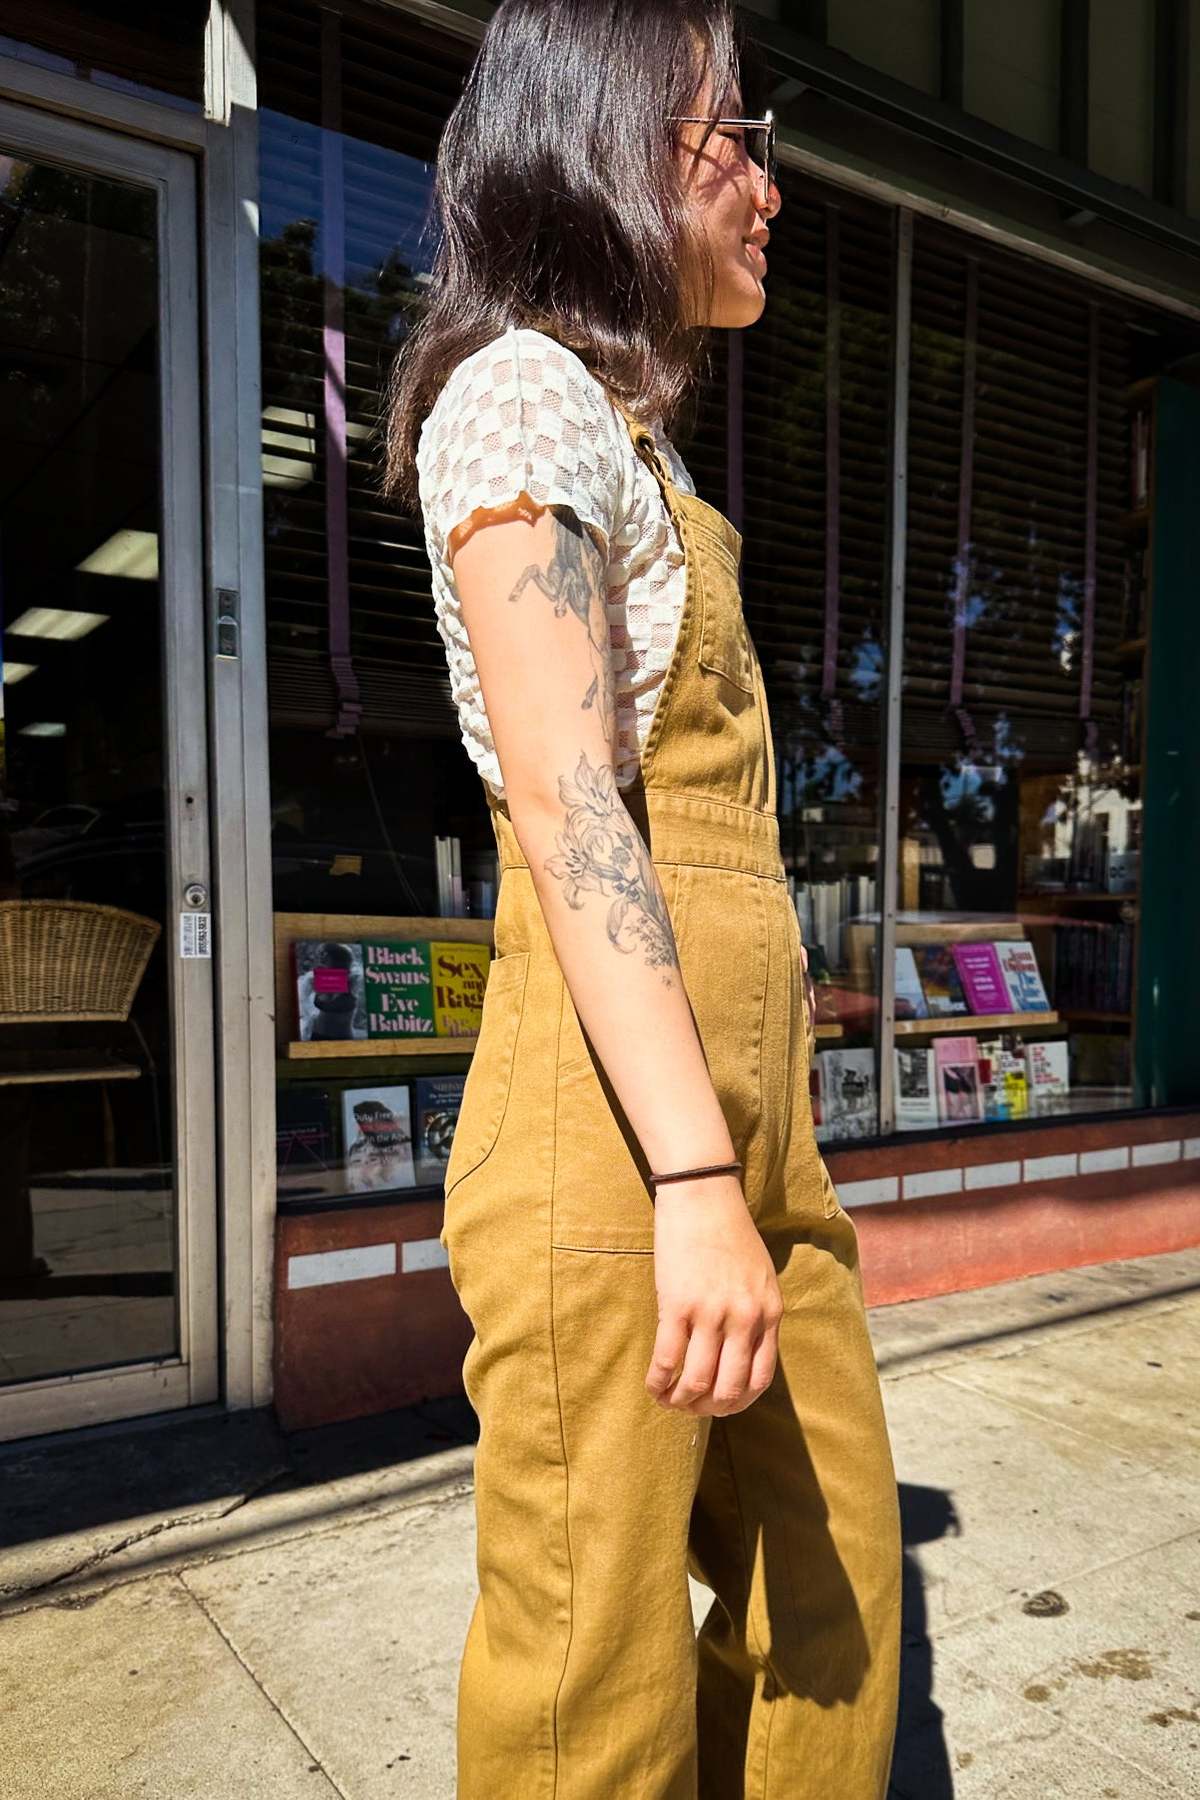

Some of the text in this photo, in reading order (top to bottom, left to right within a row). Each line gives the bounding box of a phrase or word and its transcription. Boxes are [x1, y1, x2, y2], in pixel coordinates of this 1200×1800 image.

[367, 946, 425, 965] Black
[365, 966, 431, 985] Swans
[438, 955, 487, 984] Sex
[381, 993, 419, 1012] Eve
[436, 985, 484, 1013] Rag
[369, 1013, 434, 1033] Babitz
